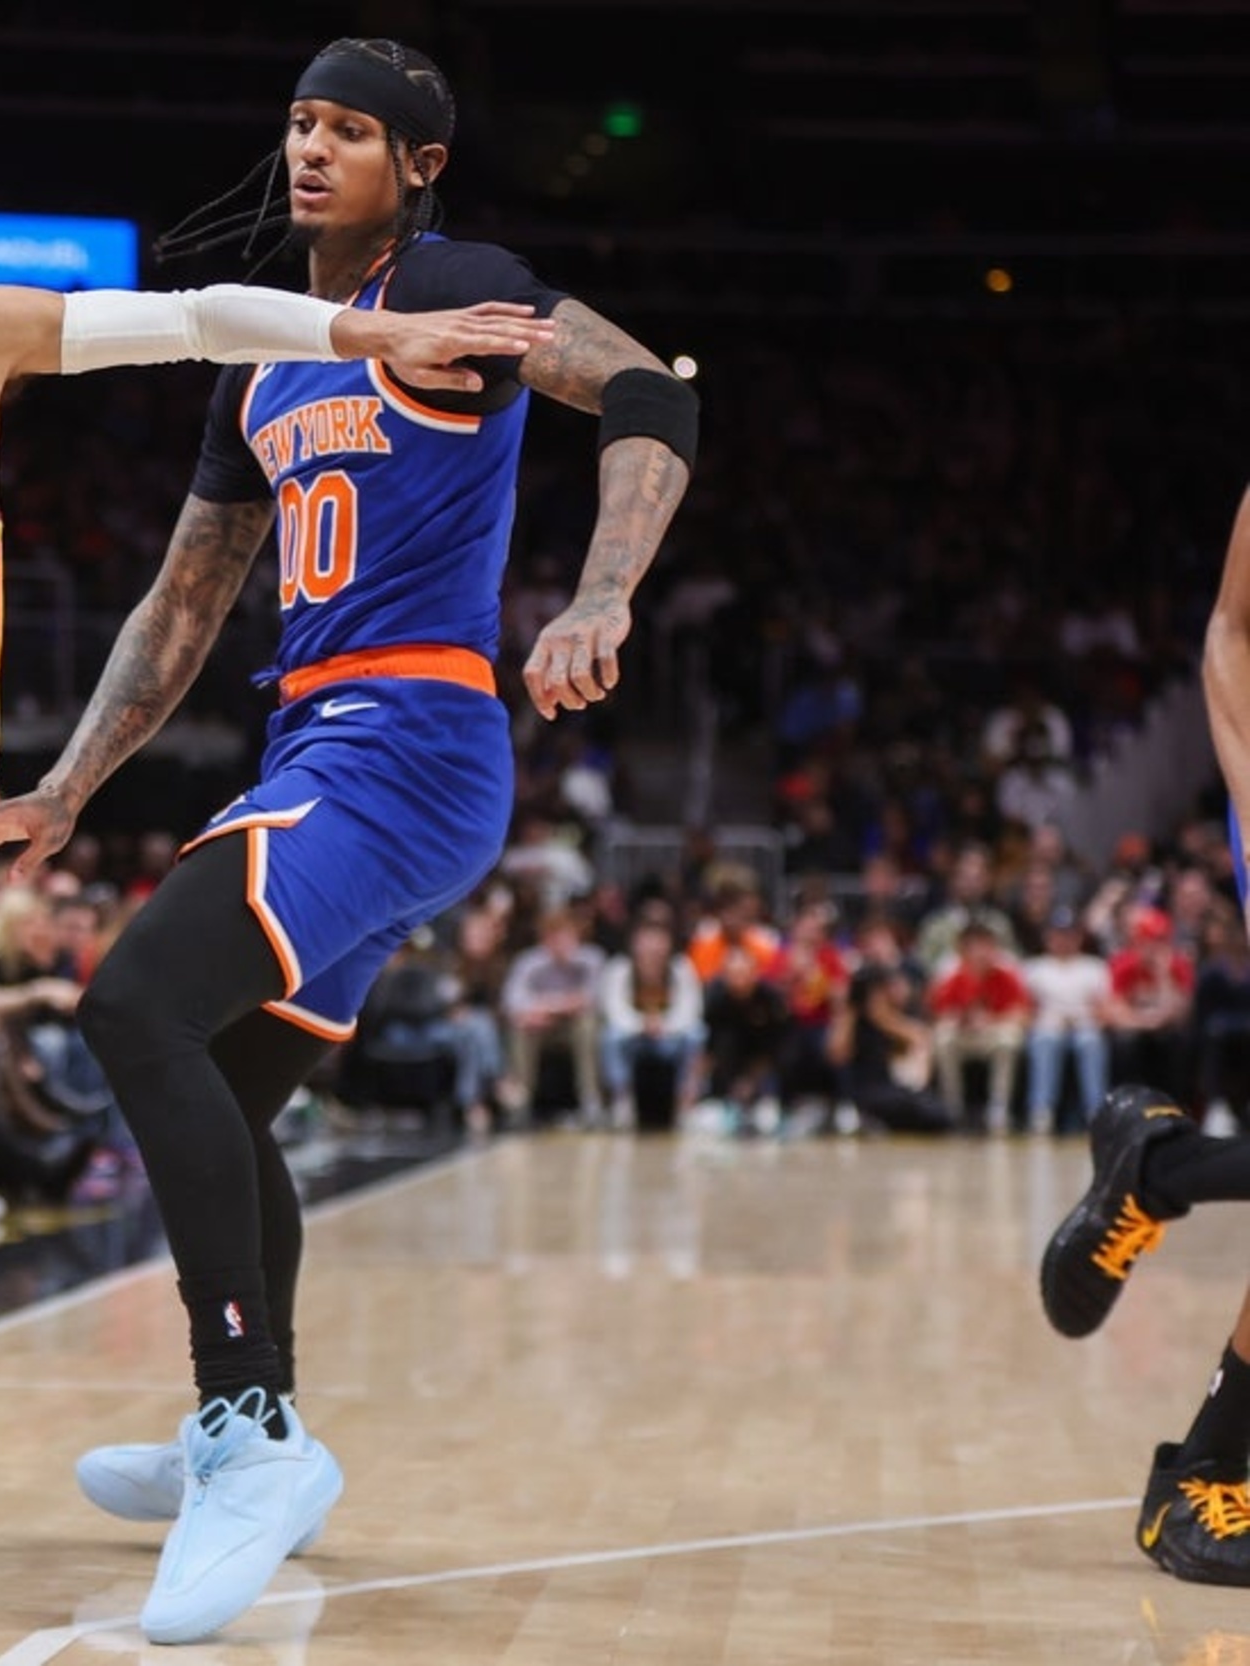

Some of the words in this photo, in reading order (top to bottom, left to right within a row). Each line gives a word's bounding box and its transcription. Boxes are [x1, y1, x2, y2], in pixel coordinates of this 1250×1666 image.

[251, 412, 295, 483] EW
[295, 395, 392, 461] YORK
[280, 470, 357, 610] 00
